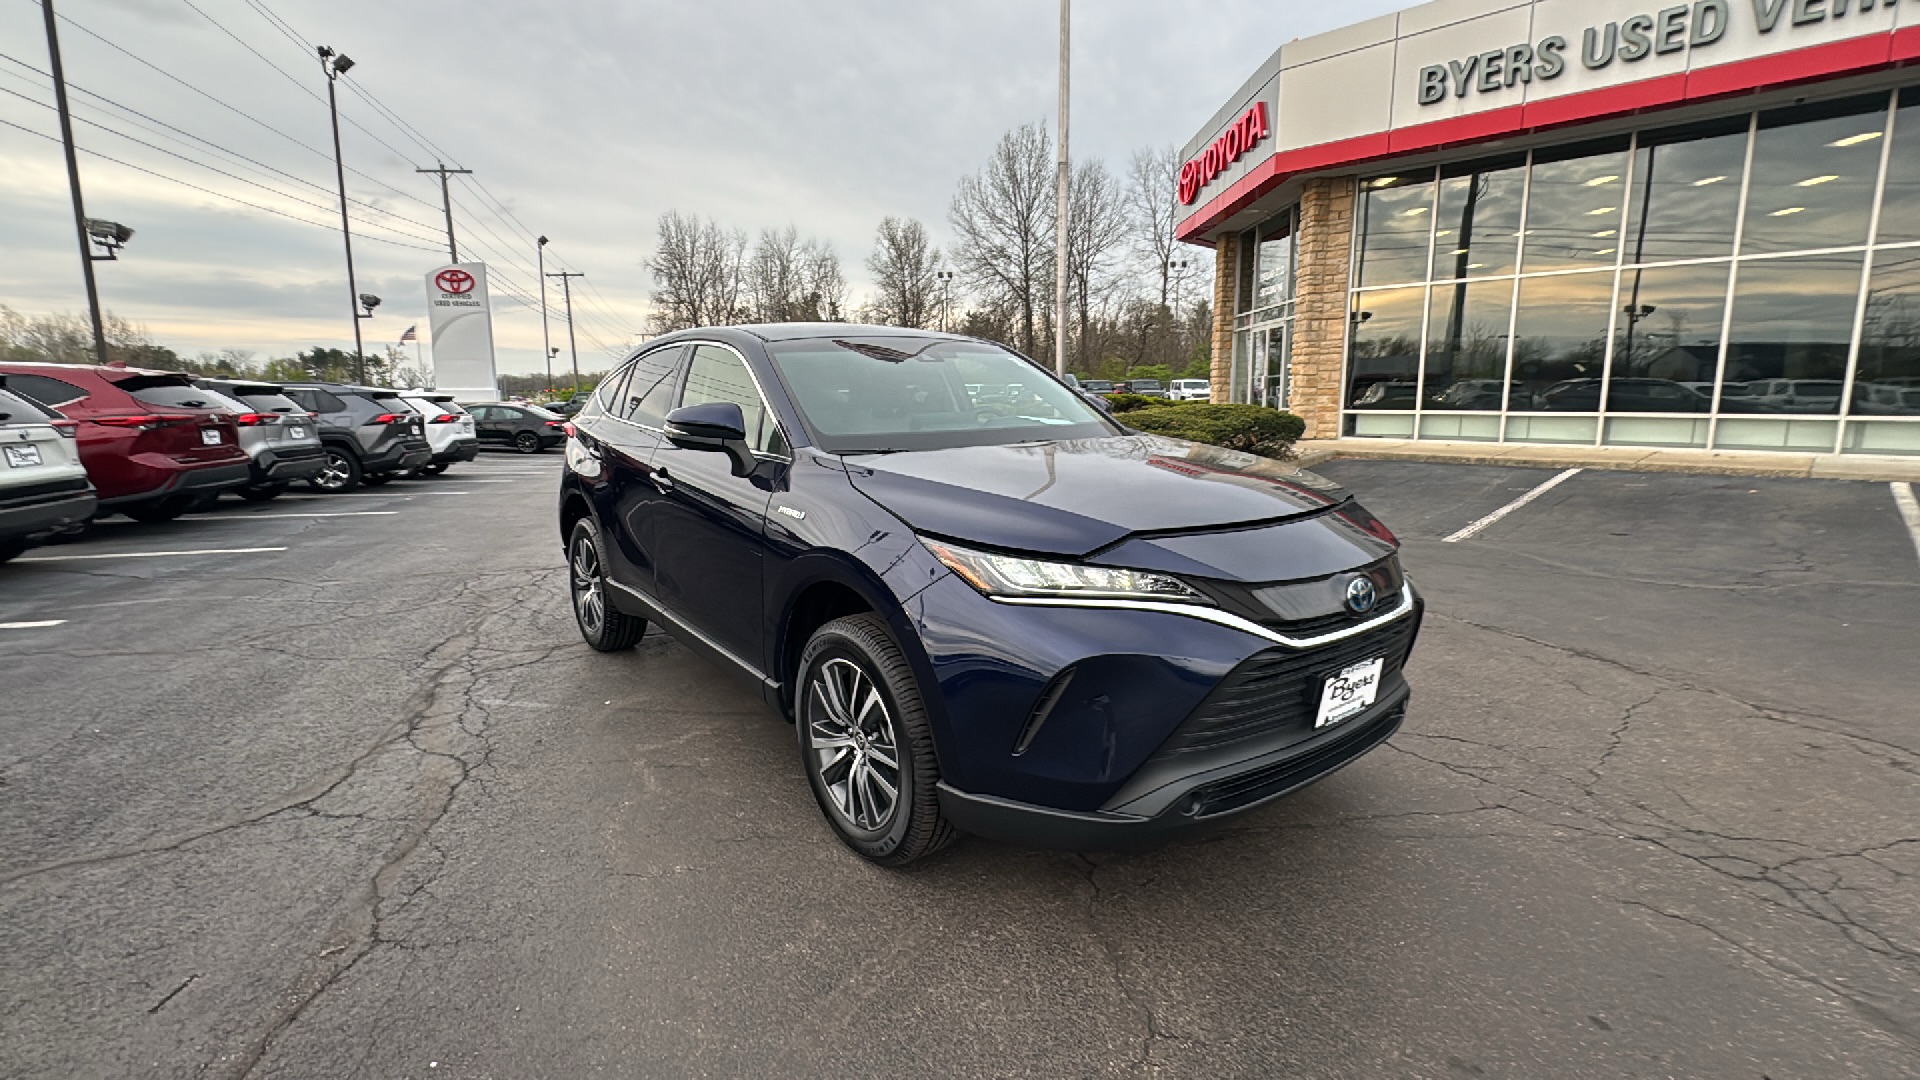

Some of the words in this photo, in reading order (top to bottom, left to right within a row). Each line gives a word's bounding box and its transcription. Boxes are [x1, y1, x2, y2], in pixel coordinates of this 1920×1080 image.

[1418, 35, 1566, 105] BYERS
[1581, 0, 1729, 70] USED
[1199, 101, 1267, 187] TOYOTA
[1328, 674, 1374, 701] Byers
